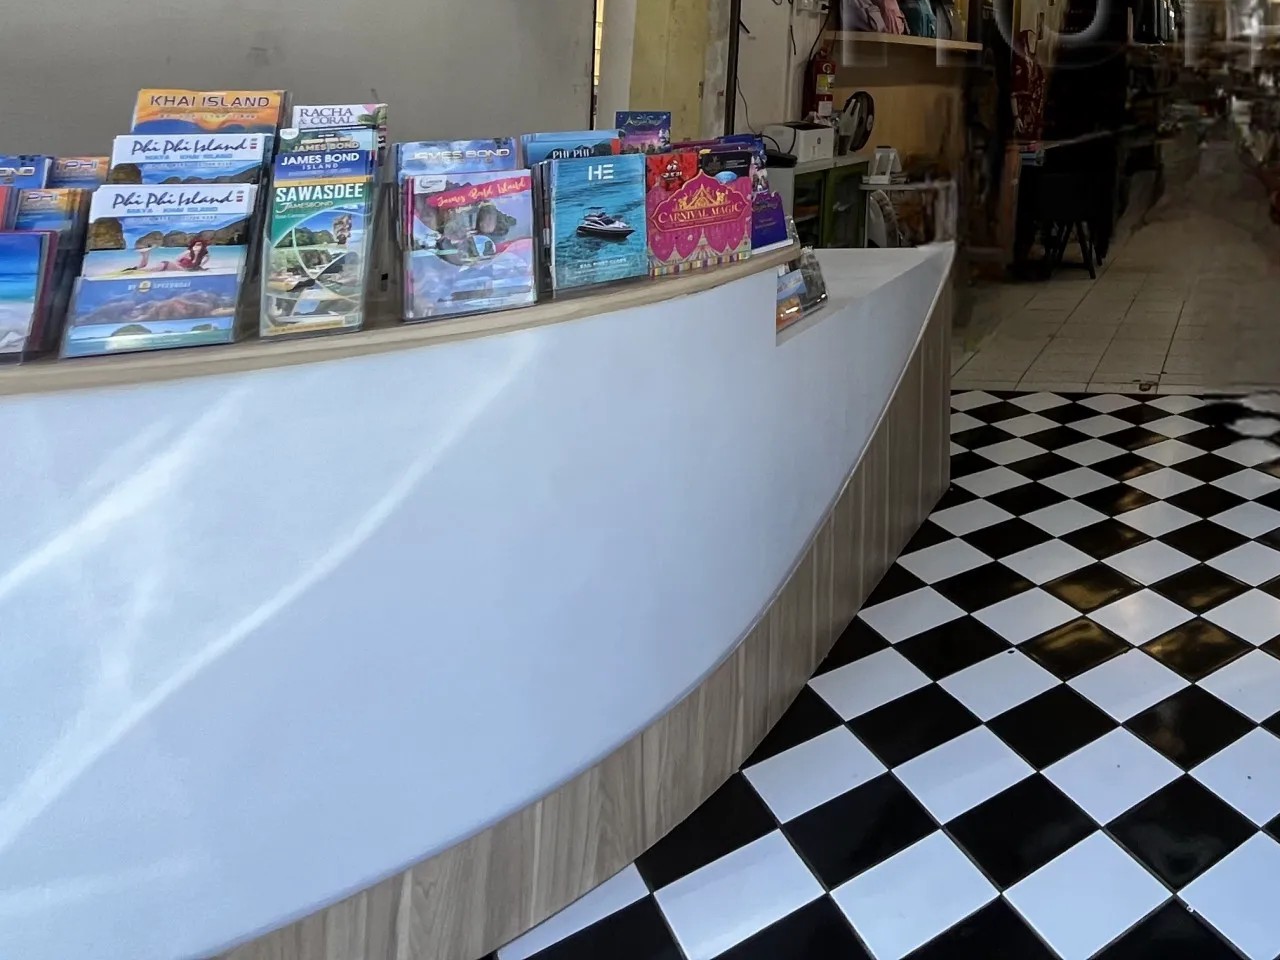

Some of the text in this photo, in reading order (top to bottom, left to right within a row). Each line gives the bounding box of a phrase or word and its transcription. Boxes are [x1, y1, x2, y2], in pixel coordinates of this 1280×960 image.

[150, 95, 270, 108] KHAI ISLAND
[300, 107, 353, 117] RACHA
[311, 117, 354, 125] CORAL
[132, 138, 247, 155] Phi Phi Island
[293, 141, 360, 152] JAMES BOND
[281, 153, 360, 166] JAMES BOND
[413, 149, 510, 161] JAMES BOND
[276, 183, 364, 202] SAWASDEE
[113, 191, 233, 208] Phi Phi Island
[658, 210, 709, 224] CARNIVAL
[711, 202, 743, 216] MAGIC
